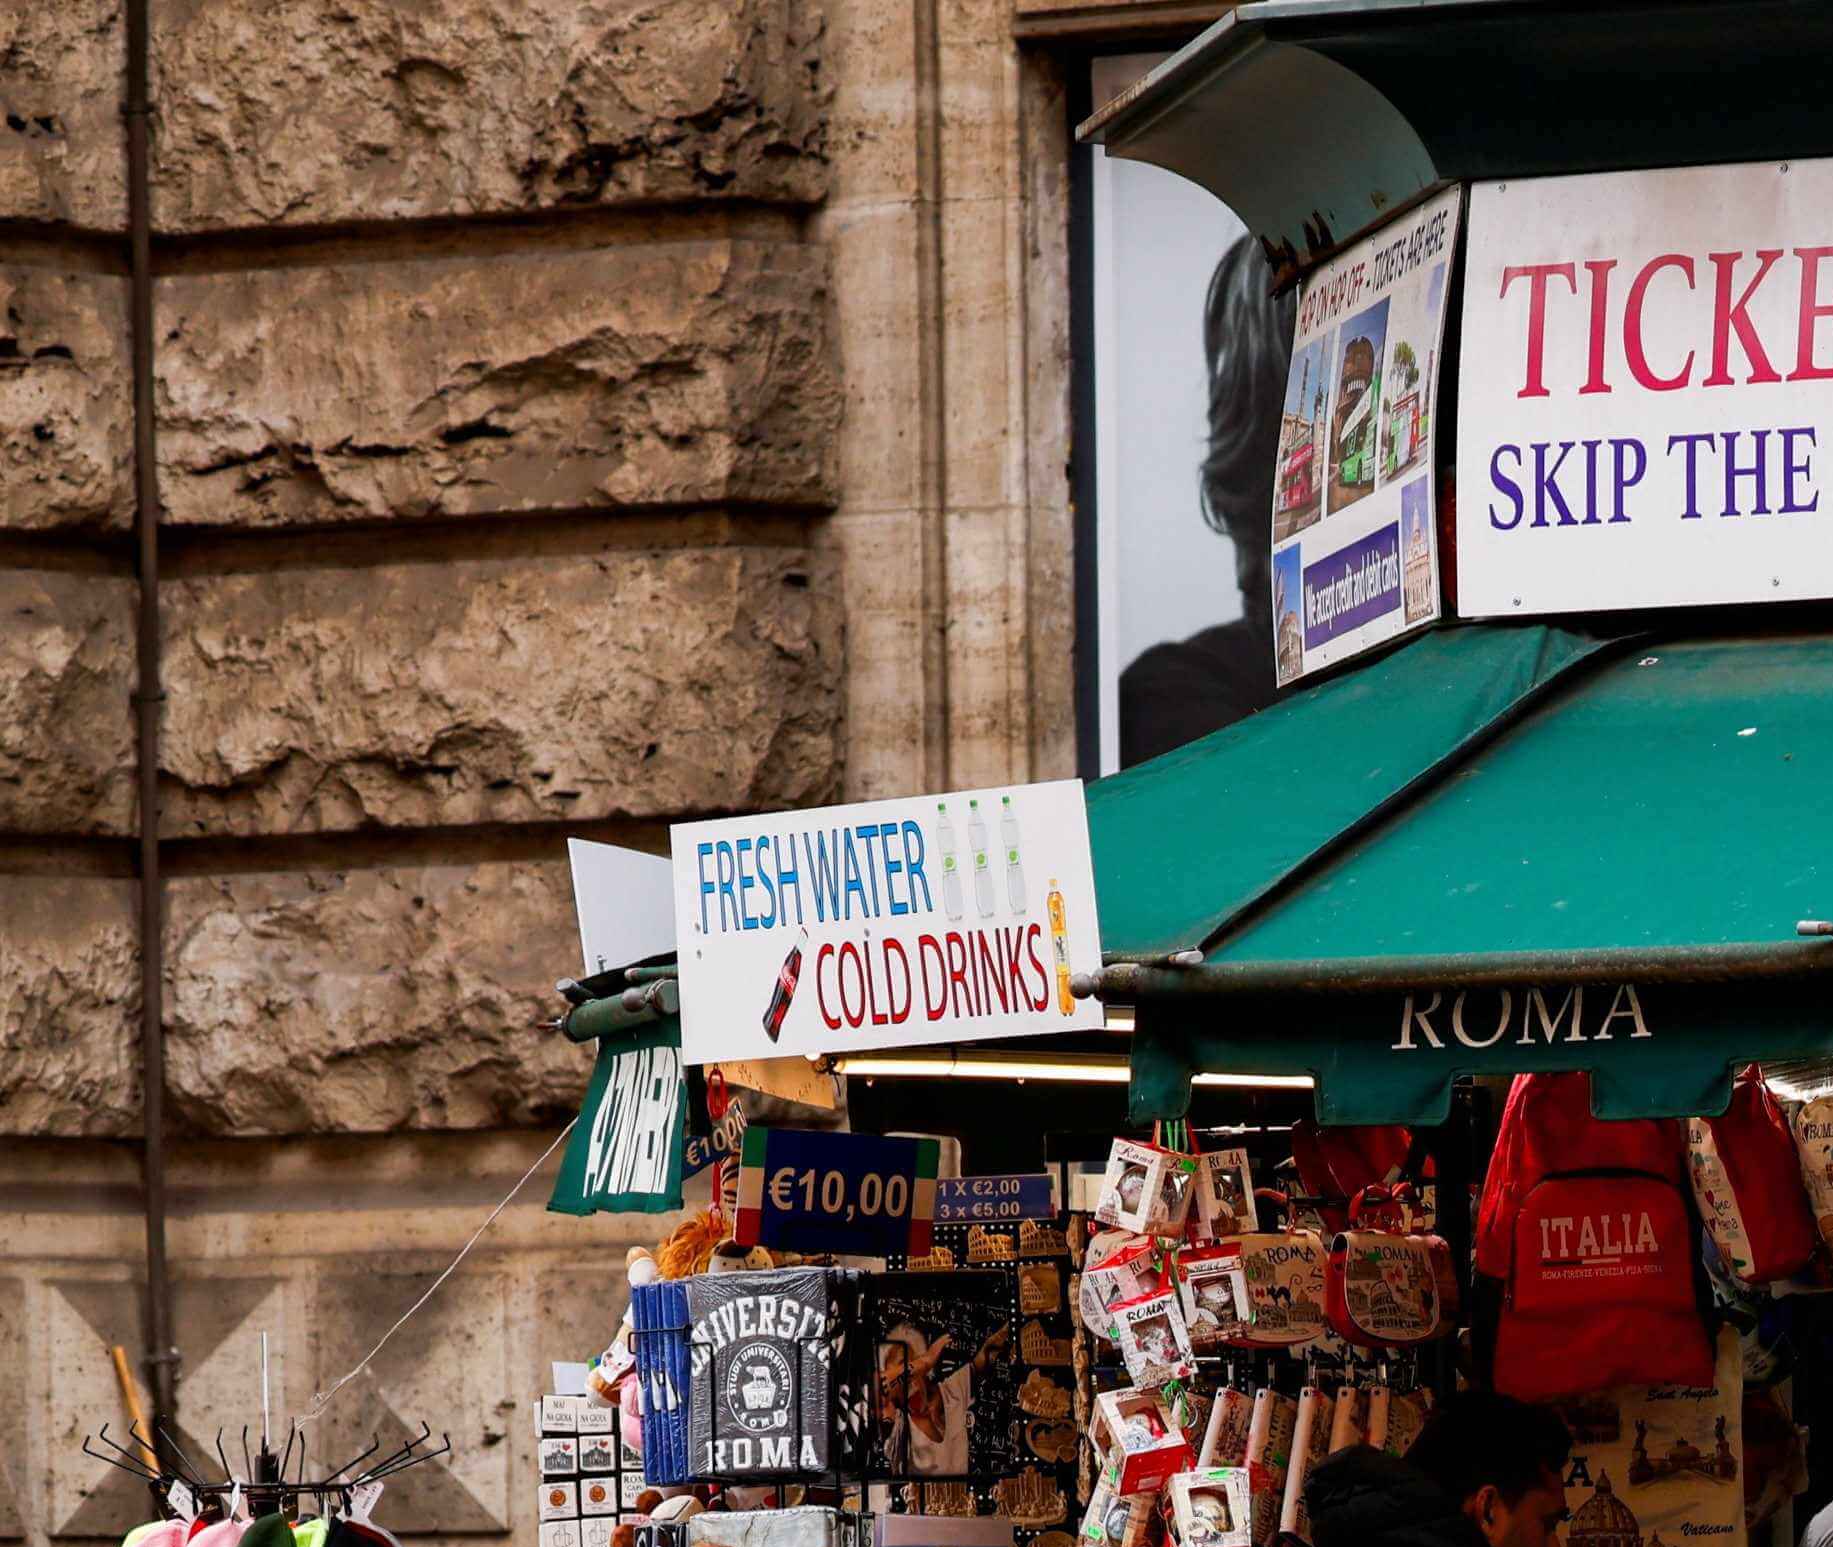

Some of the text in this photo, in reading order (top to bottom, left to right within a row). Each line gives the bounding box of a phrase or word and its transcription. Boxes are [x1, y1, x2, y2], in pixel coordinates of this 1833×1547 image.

[1373, 237, 1408, 294] TICKETS
[1425, 209, 1448, 260] HERE
[1490, 441, 1647, 530] SKIP
[1667, 427, 1819, 522] THE
[697, 820, 933, 934] FRESH WATER
[816, 923, 1049, 1031] COLD DRINKS
[1392, 984, 1653, 1050] ROMA
[768, 1167, 909, 1218] €10,00
[971, 1178, 1020, 1197] €2,00
[971, 1199, 1020, 1219] €5,00
[1540, 1212, 1659, 1259] ITALIA
[705, 1435, 819, 1473] ROMA
[1681, 1521, 1734, 1537] Vaticano
